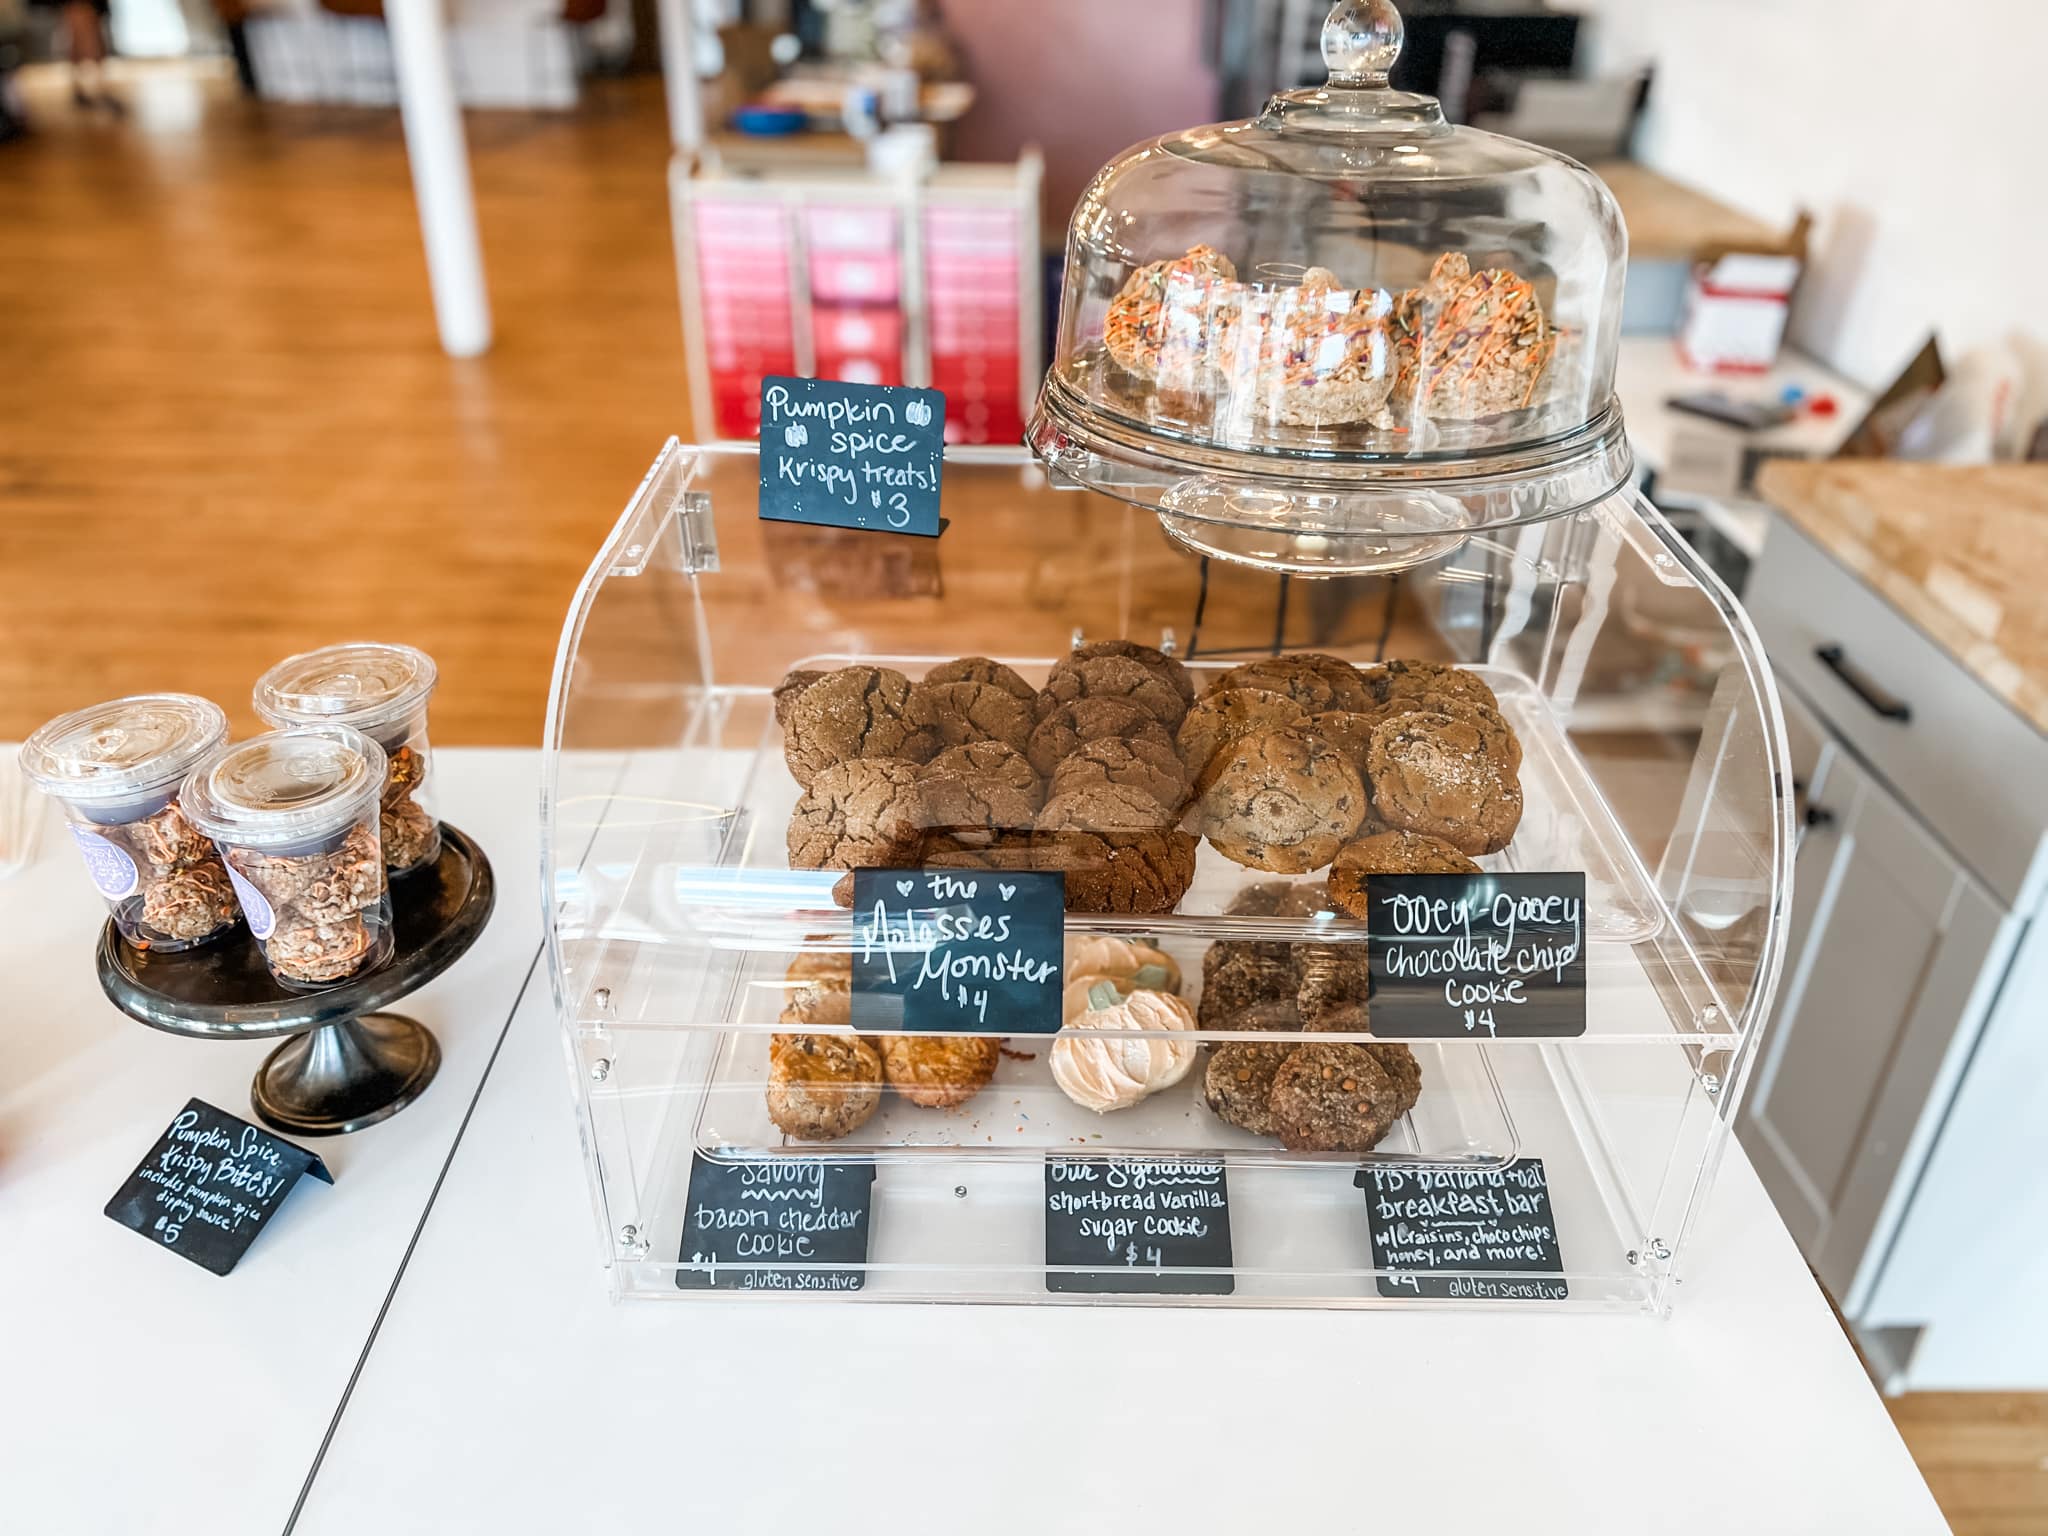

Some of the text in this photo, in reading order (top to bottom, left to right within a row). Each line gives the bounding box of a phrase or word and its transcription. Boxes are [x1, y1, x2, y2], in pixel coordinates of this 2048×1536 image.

[766, 386, 895, 429] Pumpkin
[830, 429, 917, 459] spice
[779, 456, 937, 505] Krispy treats!
[928, 876, 978, 900] the
[912, 949, 1058, 1001] Monster
[1517, 938, 1577, 983] chip
[957, 984, 988, 1023] $4
[1464, 1008, 1496, 1038] $4
[167, 1111, 230, 1154] Pumpkin
[160, 1144, 285, 1206] Krispy Bites!
[139, 1165, 261, 1221] includes pumpkin spice
[1049, 1190, 1155, 1215] shortbread
[1376, 1188, 1544, 1219] breakfast bar
[156, 1192, 242, 1233] dipping sauce!
[694, 1203, 863, 1232] bacon cheddar
[1386, 1244, 1547, 1267] honey, and more!
[744, 1270, 859, 1290] gluten sensitive
[1449, 1277, 1567, 1300] gluten sensitive
